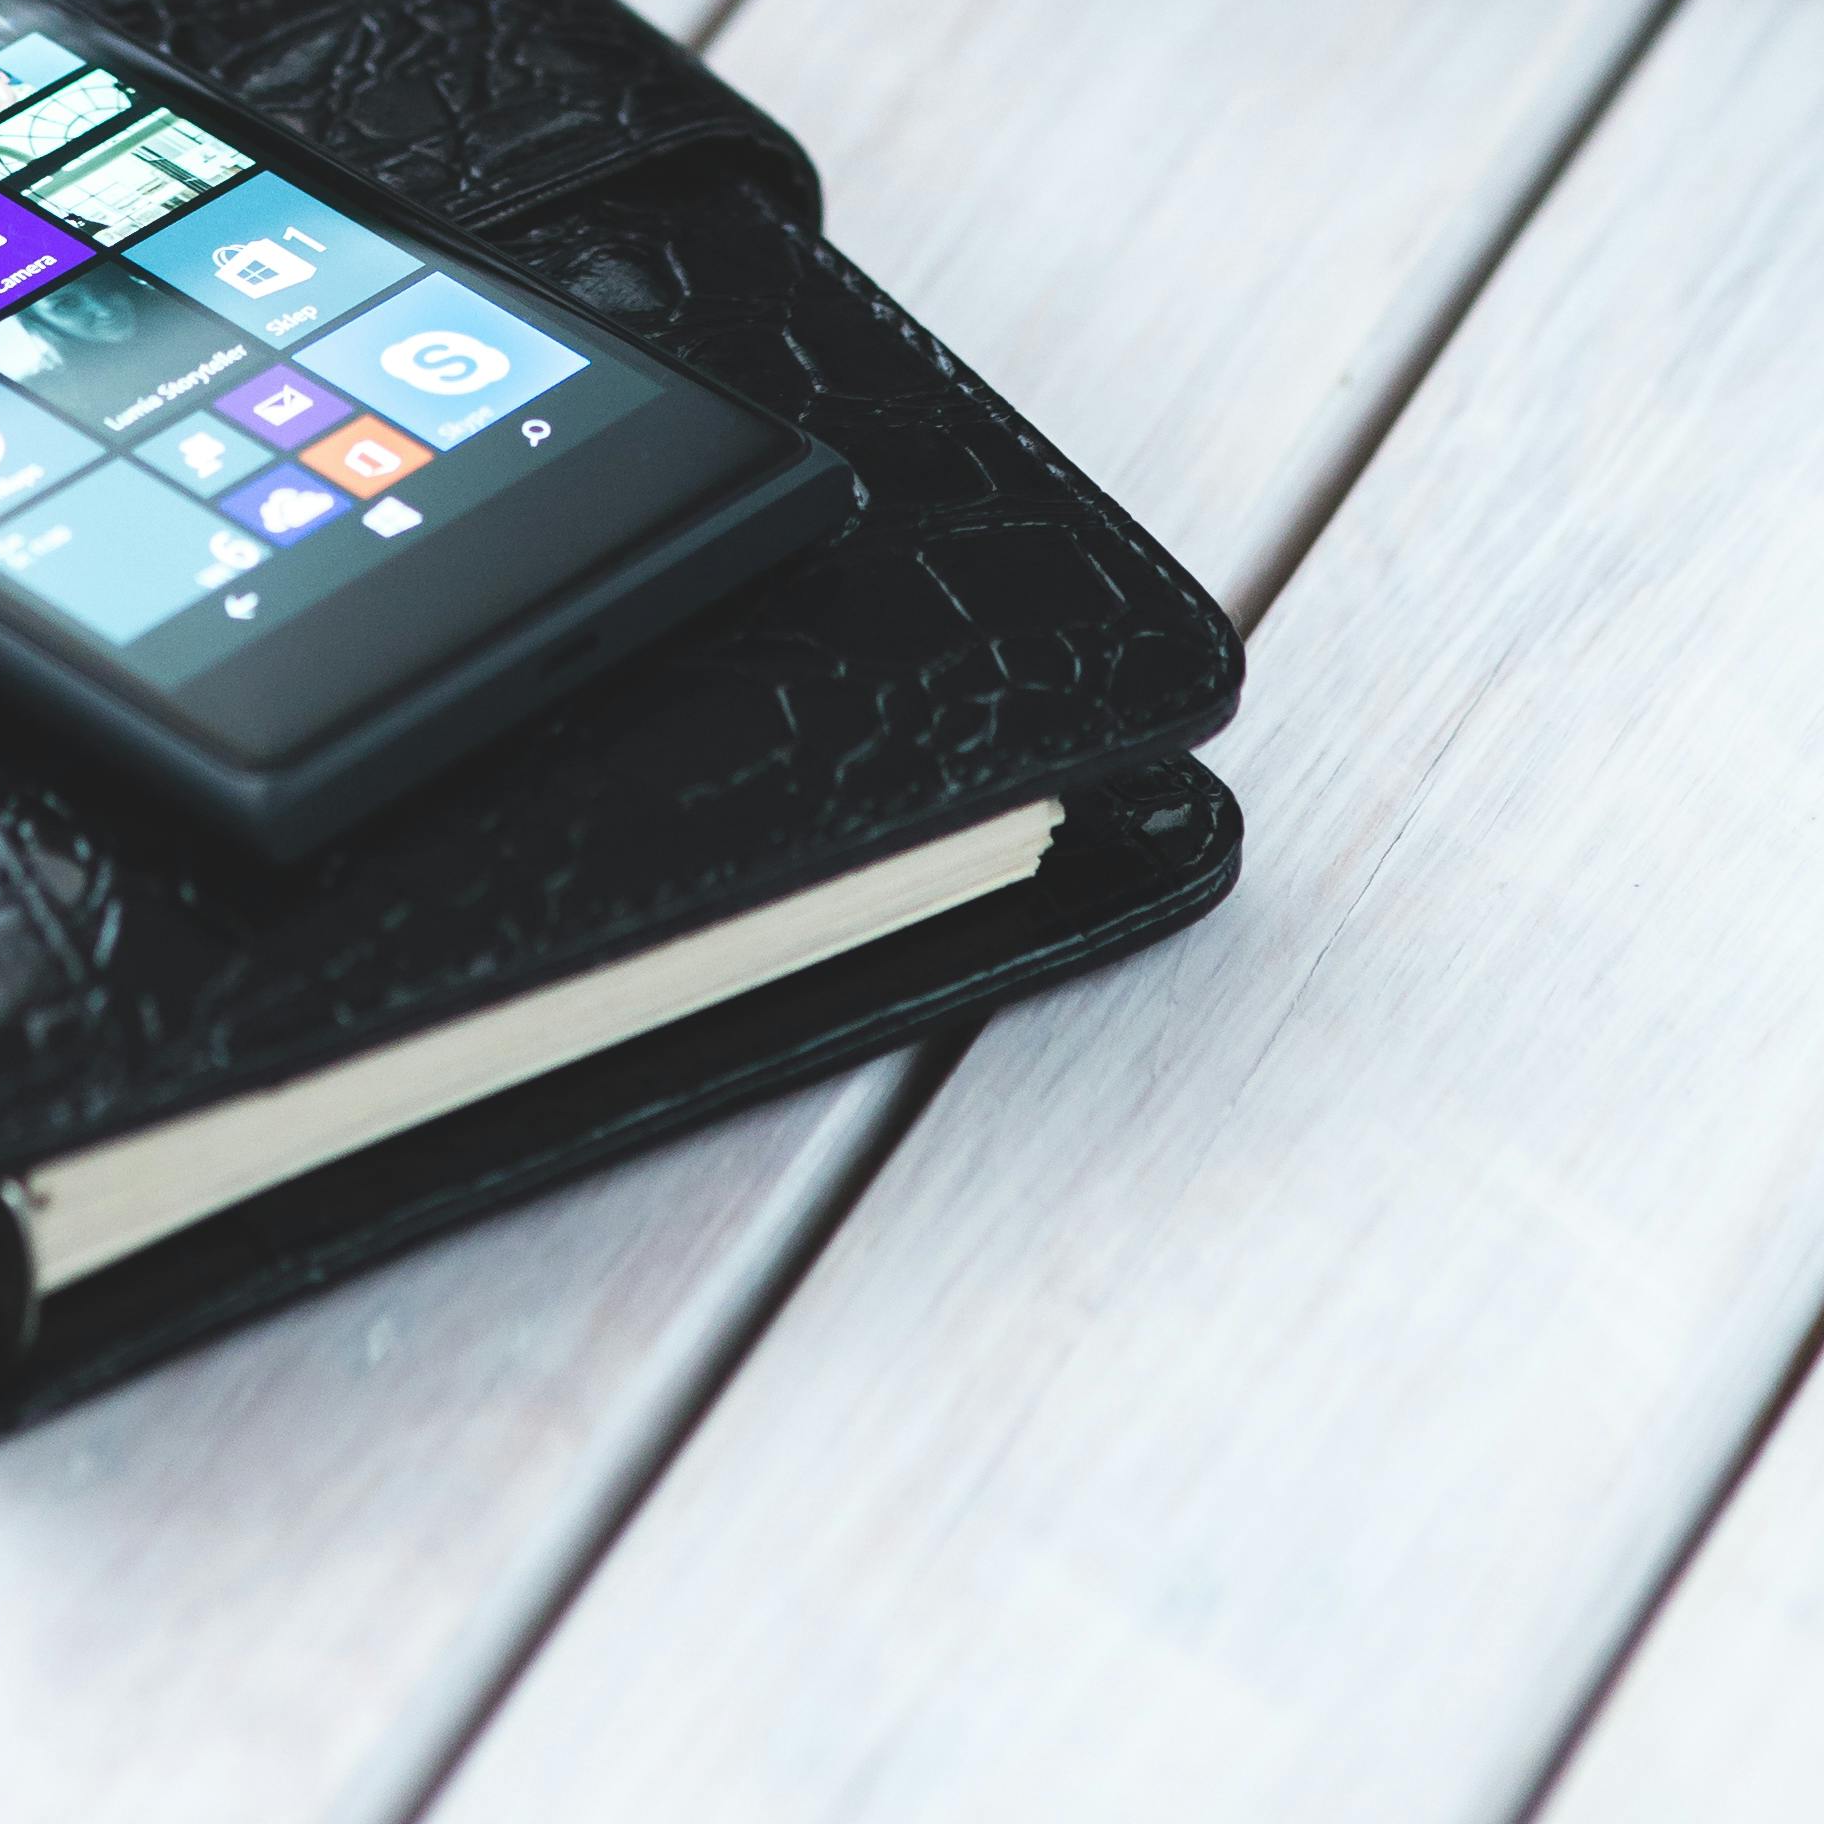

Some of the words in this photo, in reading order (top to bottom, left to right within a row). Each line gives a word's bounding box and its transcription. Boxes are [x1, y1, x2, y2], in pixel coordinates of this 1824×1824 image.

[282, 225, 328, 253] 1
[265, 304, 319, 337] Sklep
[103, 394, 165, 432] Lumia
[157, 344, 248, 401] Storyteller
[437, 405, 495, 442] Skype
